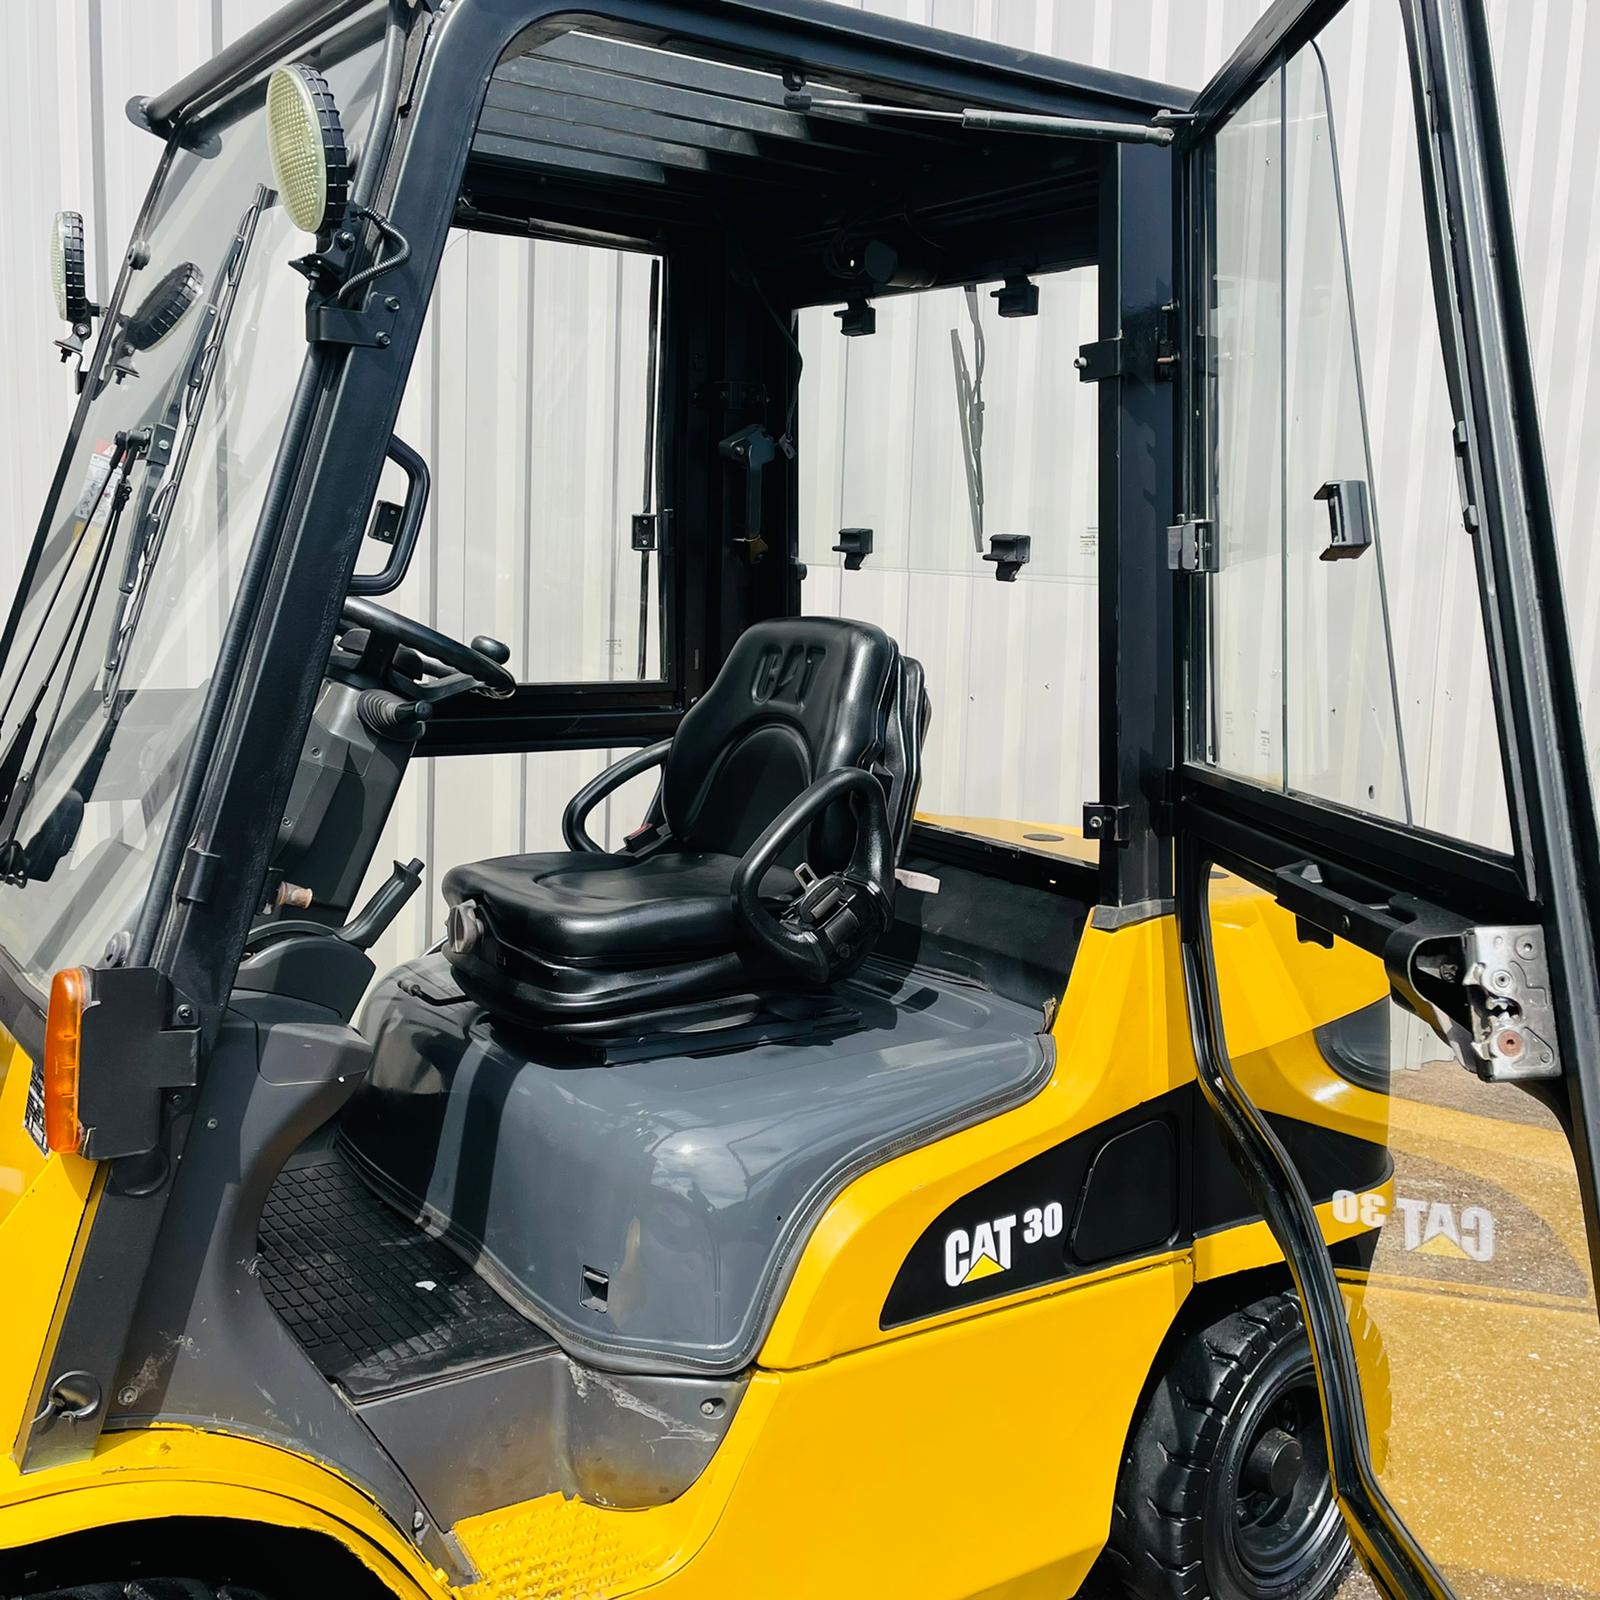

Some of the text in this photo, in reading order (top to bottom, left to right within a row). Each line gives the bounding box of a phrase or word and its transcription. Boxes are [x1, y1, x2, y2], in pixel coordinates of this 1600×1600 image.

[752, 643, 827, 708] CAT
[945, 1202, 1063, 1287] CAT 30
